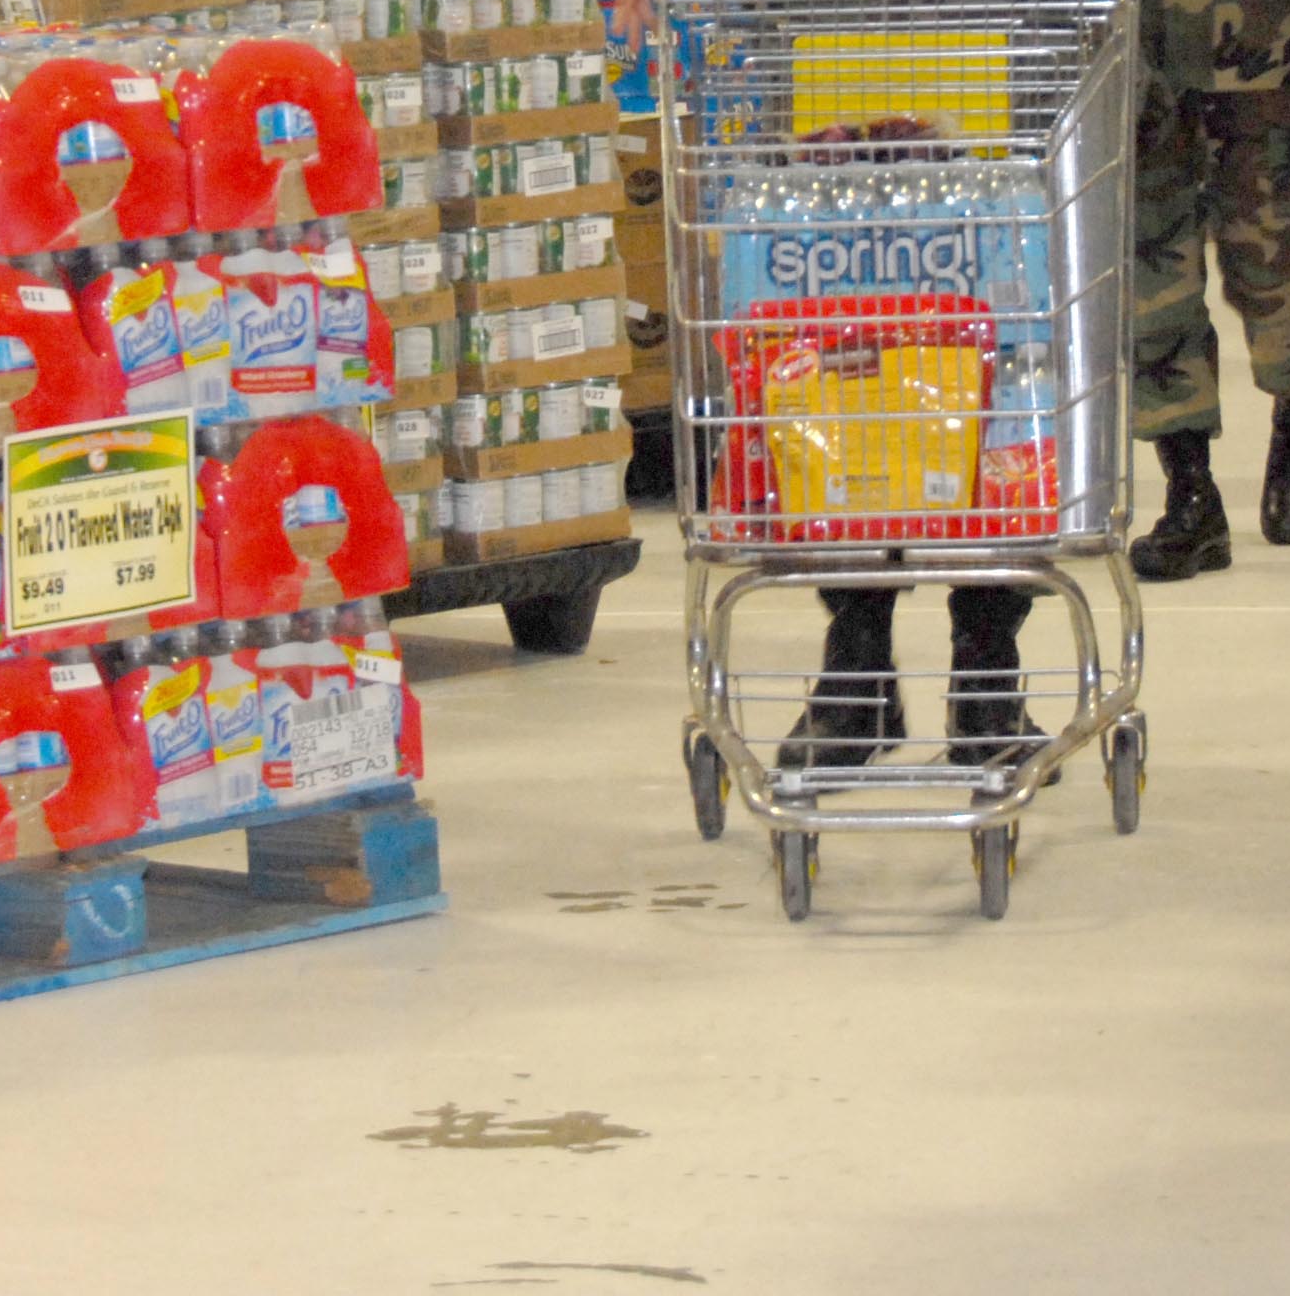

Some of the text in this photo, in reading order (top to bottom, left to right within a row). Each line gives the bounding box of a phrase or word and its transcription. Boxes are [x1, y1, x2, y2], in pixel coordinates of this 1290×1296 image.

[769, 222, 977, 296] spring!
[68, 502, 119, 550] Flavored
[120, 500, 154, 542] Water
[21, 563, 156, 601] $9.49 $7.99
